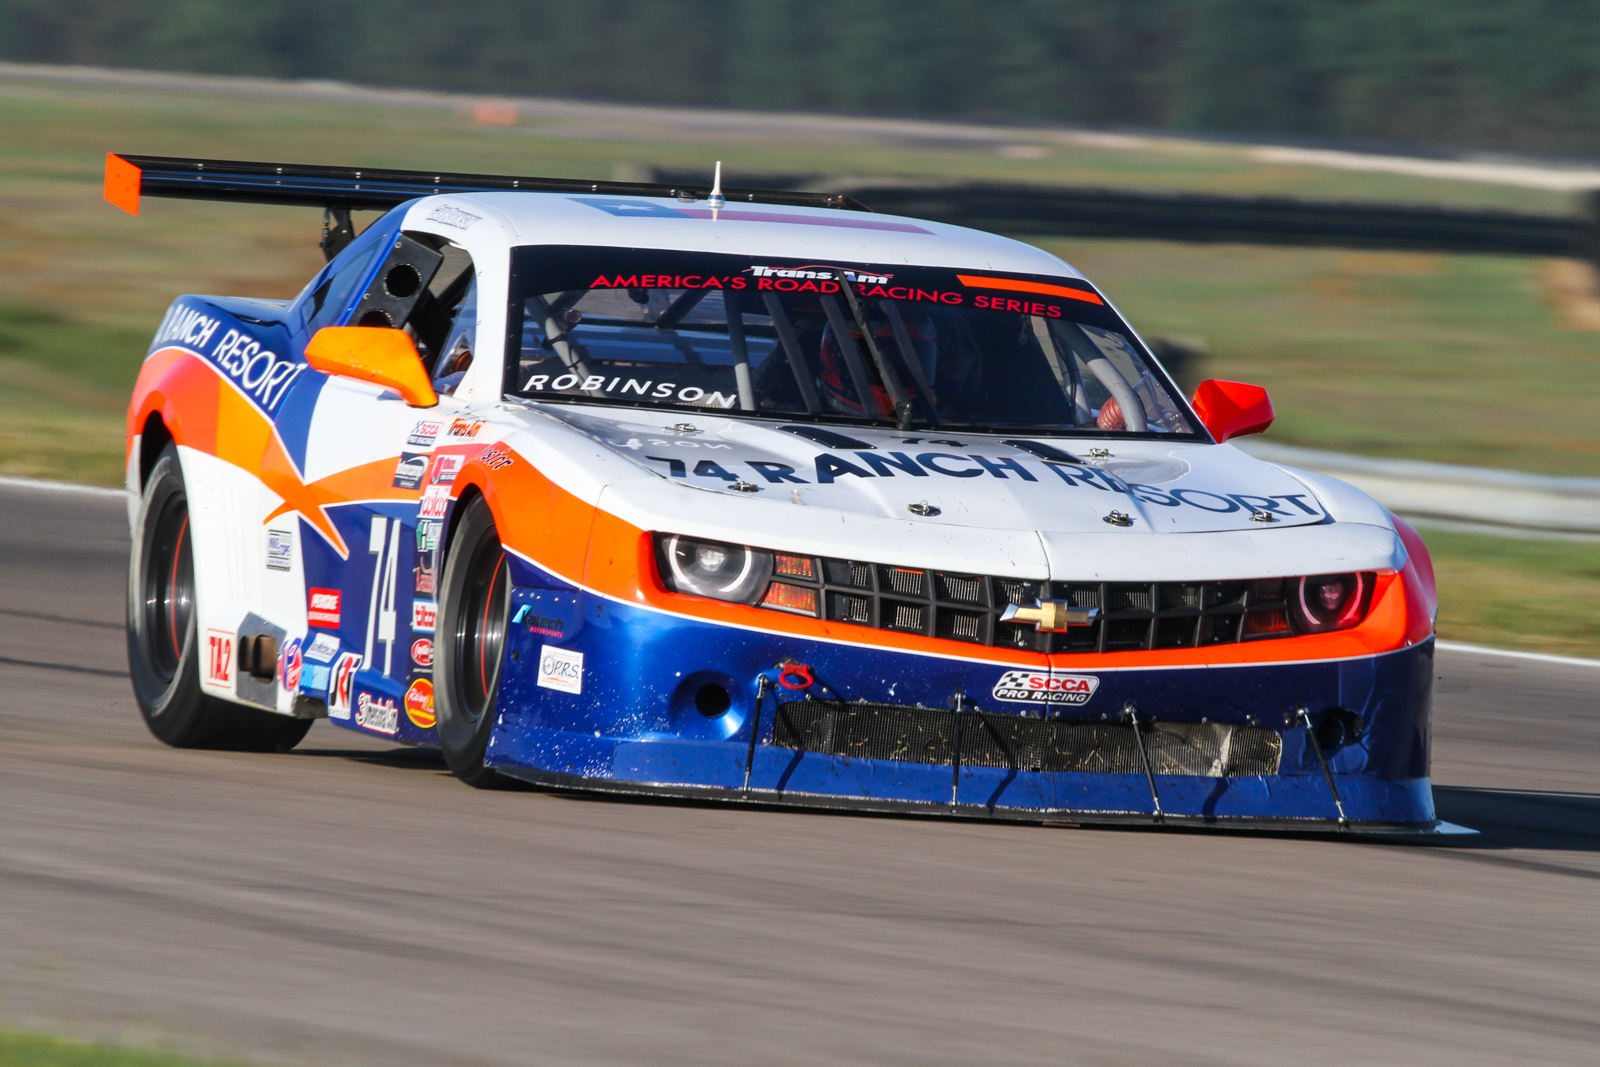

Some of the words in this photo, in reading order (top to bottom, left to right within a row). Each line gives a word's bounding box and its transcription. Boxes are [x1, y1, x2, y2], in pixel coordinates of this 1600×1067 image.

[589, 274, 747, 291] AMERICA'S
[757, 278, 841, 294] ROAD
[855, 284, 964, 305] RACING
[973, 295, 1063, 318] SERIES
[211, 329, 308, 411] RESORT
[522, 374, 738, 408] ROBINSON
[644, 455, 740, 482] 74
[744, 450, 1039, 484] RANCH
[360, 515, 402, 679] 74
[997, 689, 1028, 699] PRO
[1031, 691, 1087, 702] RACING
[1028, 677, 1090, 692] SCCA
